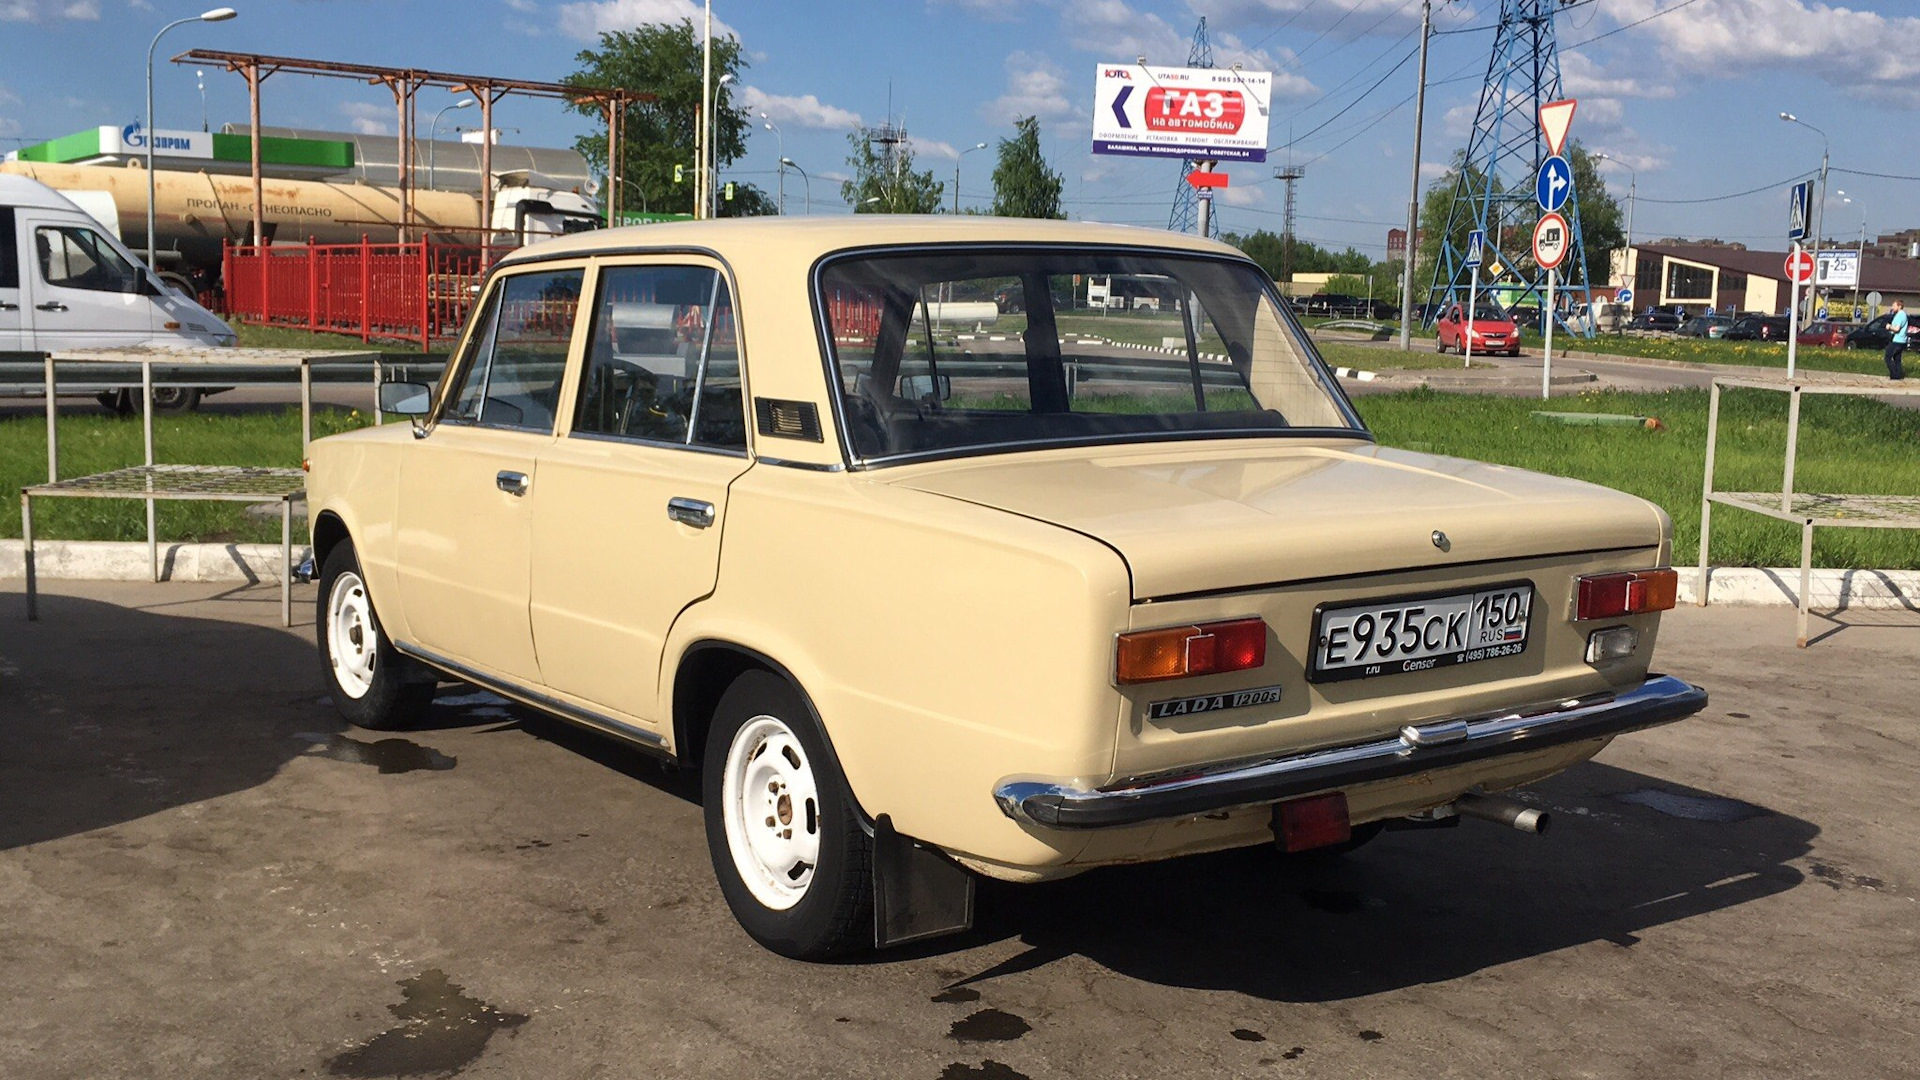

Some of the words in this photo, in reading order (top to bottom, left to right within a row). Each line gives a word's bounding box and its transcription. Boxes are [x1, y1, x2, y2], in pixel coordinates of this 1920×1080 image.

[1162, 90, 1224, 119] ГАЗ
[1152, 117, 1166, 126] на
[1167, 118, 1235, 130] автомобиль
[1099, 132, 1139, 140] ОФОРМЛЕНИЕ
[1146, 134, 1178, 142] УСТАНОВКА
[1213, 138, 1259, 146] ОБСЛУЖИВАНИЕ
[186, 198, 240, 211] ПРОПАН
[1475, 592, 1521, 630] 150
[1480, 628, 1503, 643] RUS
[1465, 650, 1485, 663] (495)
[1485, 643, 1522, 659] 786-26-26
[1365, 664, 1381, 675] r.ru
[1402, 657, 1436, 672] Genser
[1158, 696, 1224, 717] LADA
[1236, 691, 1277, 706] 1200s
